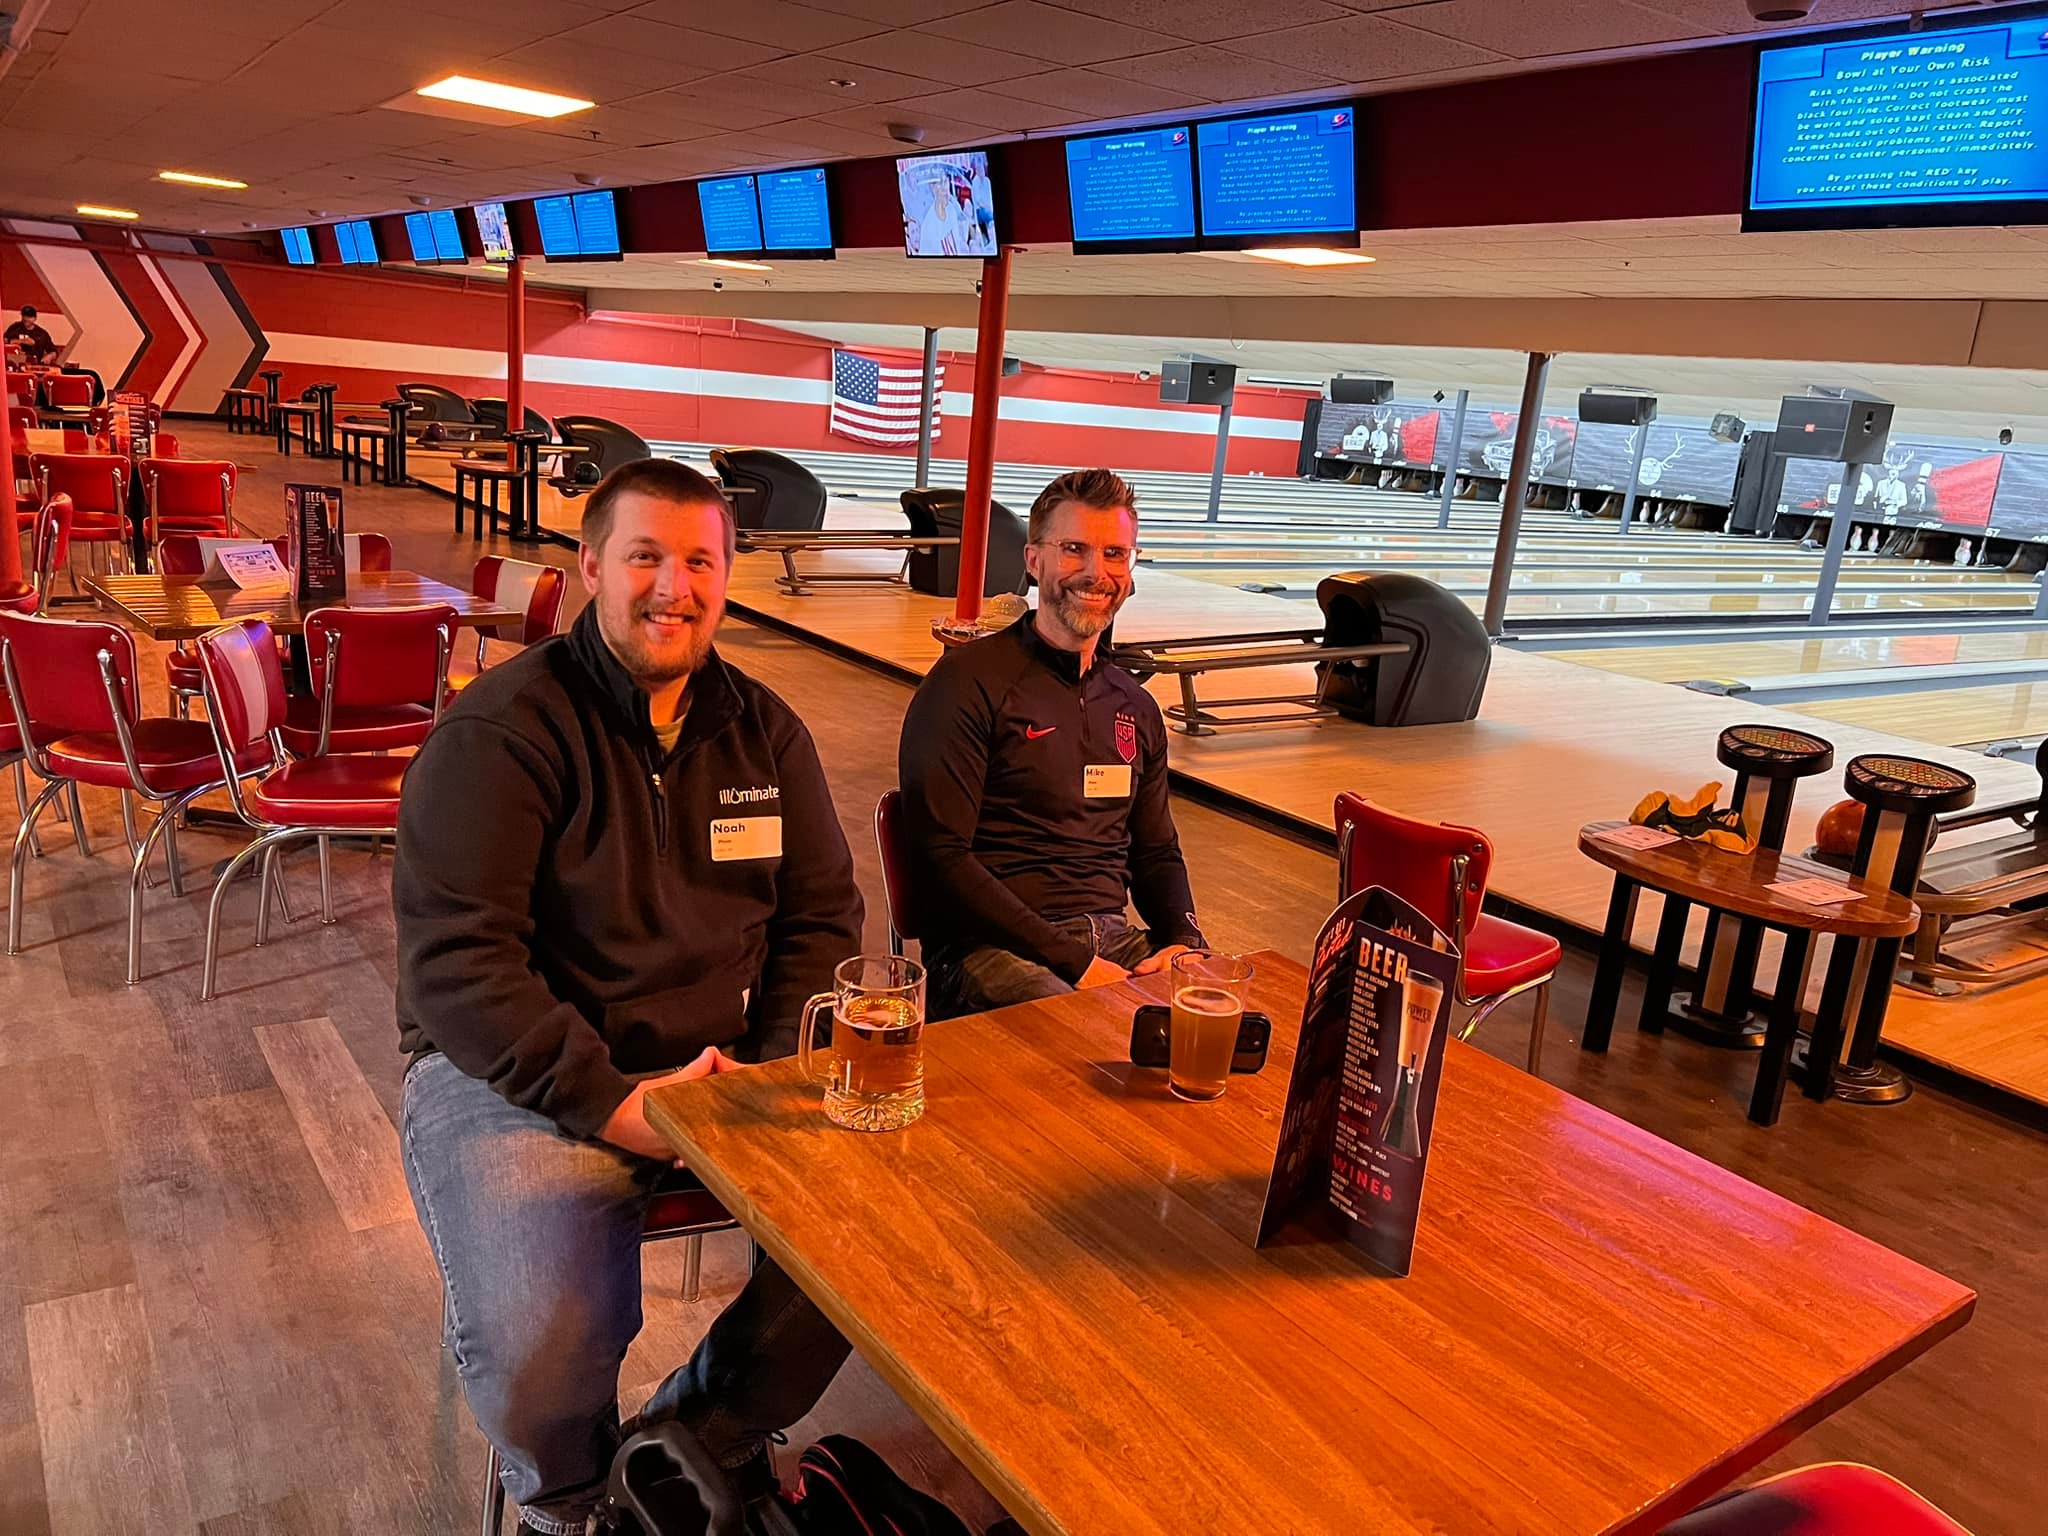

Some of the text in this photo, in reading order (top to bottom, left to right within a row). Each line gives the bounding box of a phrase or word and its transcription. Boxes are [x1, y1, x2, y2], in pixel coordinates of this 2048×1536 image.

[1861, 43, 1965, 61] Player Warning
[1836, 56, 1990, 80] Bowl at Your Own Risk
[1809, 71, 2019, 97] Risk of bodily injury is associated
[1796, 111, 1825, 120] black
[1829, 108, 1854, 117] foul
[1885, 102, 1930, 112] Correct
[1934, 98, 1992, 109] footwear
[1995, 95, 2029, 104] must
[1811, 99, 1837, 108] with
[1841, 96, 1863, 104] this
[1909, 91, 1925, 99] Do
[1928, 89, 1949, 98] not
[1953, 86, 1987, 96] cross
[1992, 84, 2013, 93] the
[1797, 123, 1810, 131] be
[1814, 121, 1841, 129] worn
[1844, 118, 1866, 127] and
[1869, 116, 1901, 125] soles
[1904, 113, 1932, 122] kept
[1936, 110, 1970, 120] clean
[1973, 108, 1997, 117] and
[1797, 133, 1824, 141] Keep
[1828, 130, 1861, 139] hands
[1864, 128, 1884, 136] out
[1887, 126, 1901, 135] of
[1904, 123, 1929, 133] ball
[1979, 118, 2023, 129] Report
[1787, 145, 1806, 153] any
[1809, 139, 1873, 151] mechanical
[1940, 132, 1975, 143] spills
[1996, 130, 2032, 139] other
[1781, 154, 1830, 163] concerns
[1834, 152, 1846, 160] to
[1849, 150, 1887, 159] center
[1890, 145, 1951, 157] personnel
[1819, 184, 1857, 193] accept
[1860, 182, 1892, 191] these
[1895, 179, 1959, 189] conditions
[1963, 177, 1978, 186] of
[1827, 173, 1841, 182] By
[1843, 171, 1894, 182] pressing
[1957, 167, 1979, 176] key
[1985, 527, 2000, 538] 57
[1086, 768, 1105, 777] Mike
[713, 823, 746, 834] Noah
[1358, 937, 1409, 985] BEER
[1333, 1153, 1393, 1202] WINES
